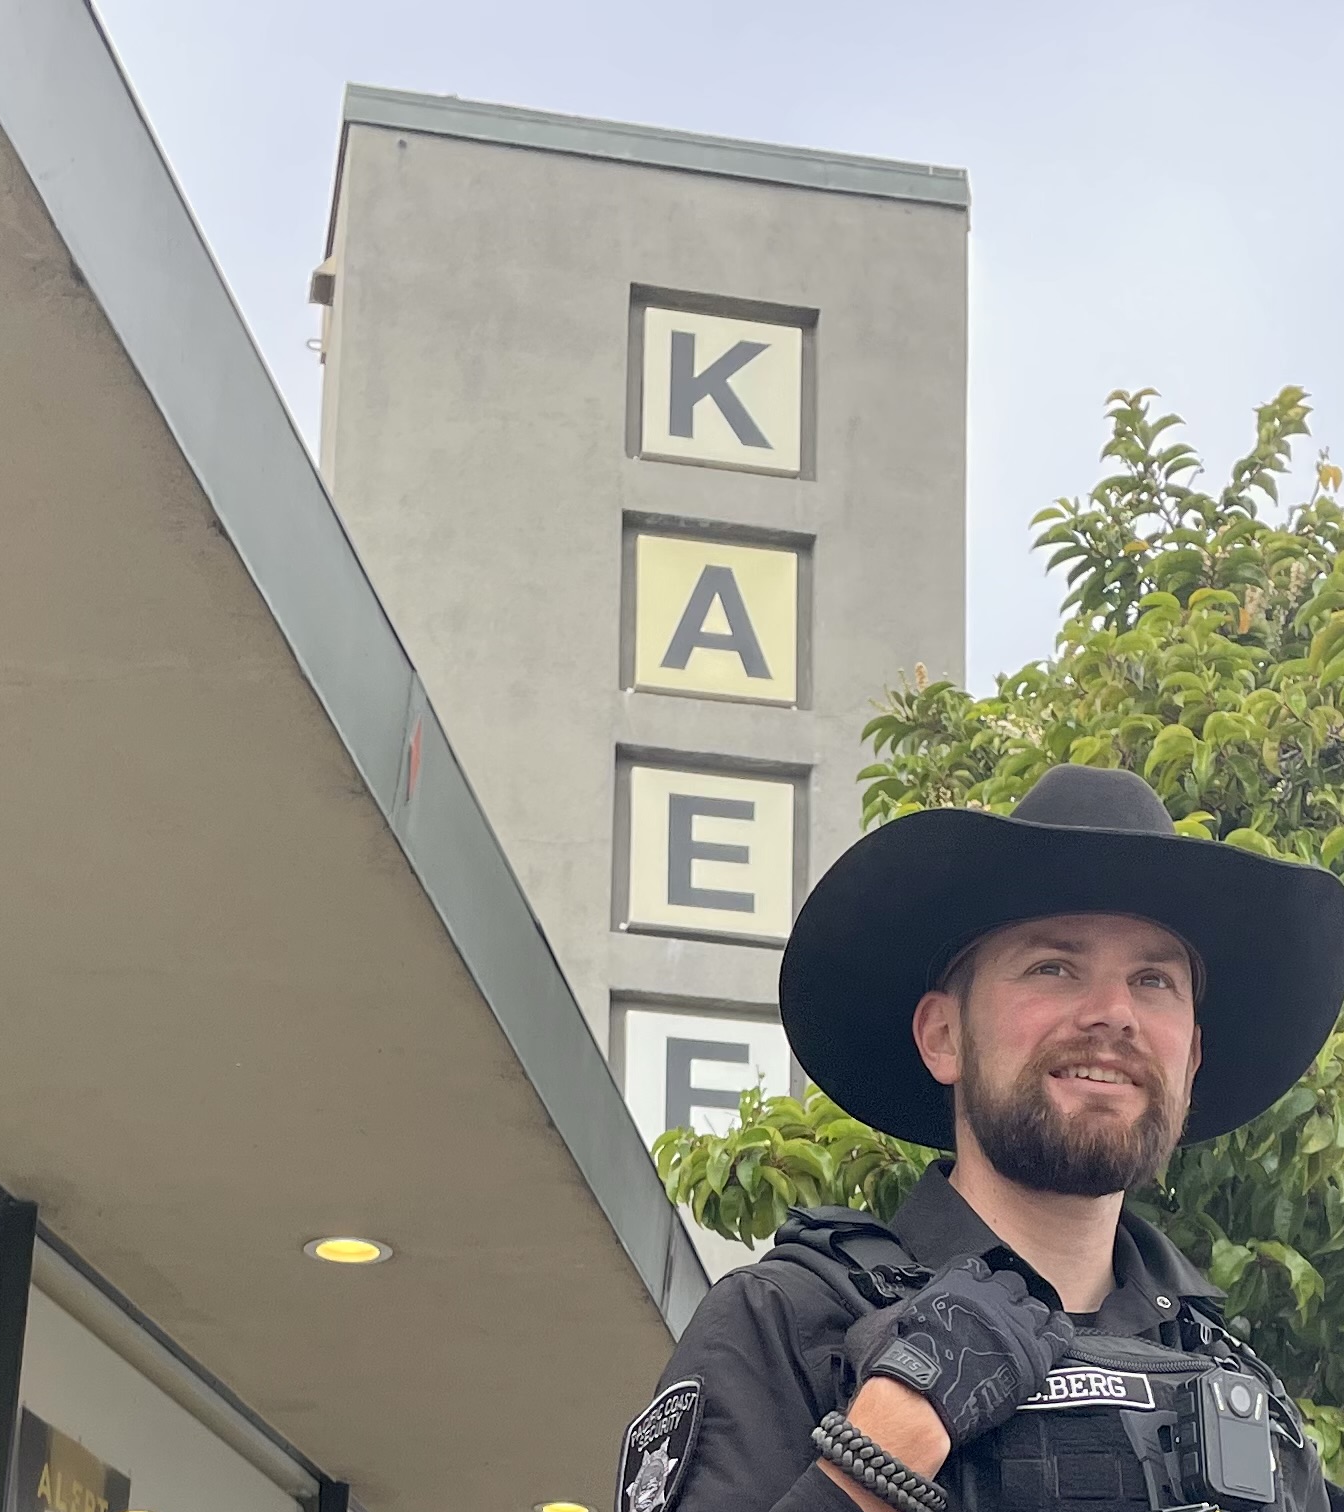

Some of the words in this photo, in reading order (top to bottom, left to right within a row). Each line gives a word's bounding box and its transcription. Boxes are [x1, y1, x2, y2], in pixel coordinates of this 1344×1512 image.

[1027, 1373, 1127, 1401] BERG
[664, 1392, 697, 1415] COAST
[637, 1411, 684, 1452] SECURITY
